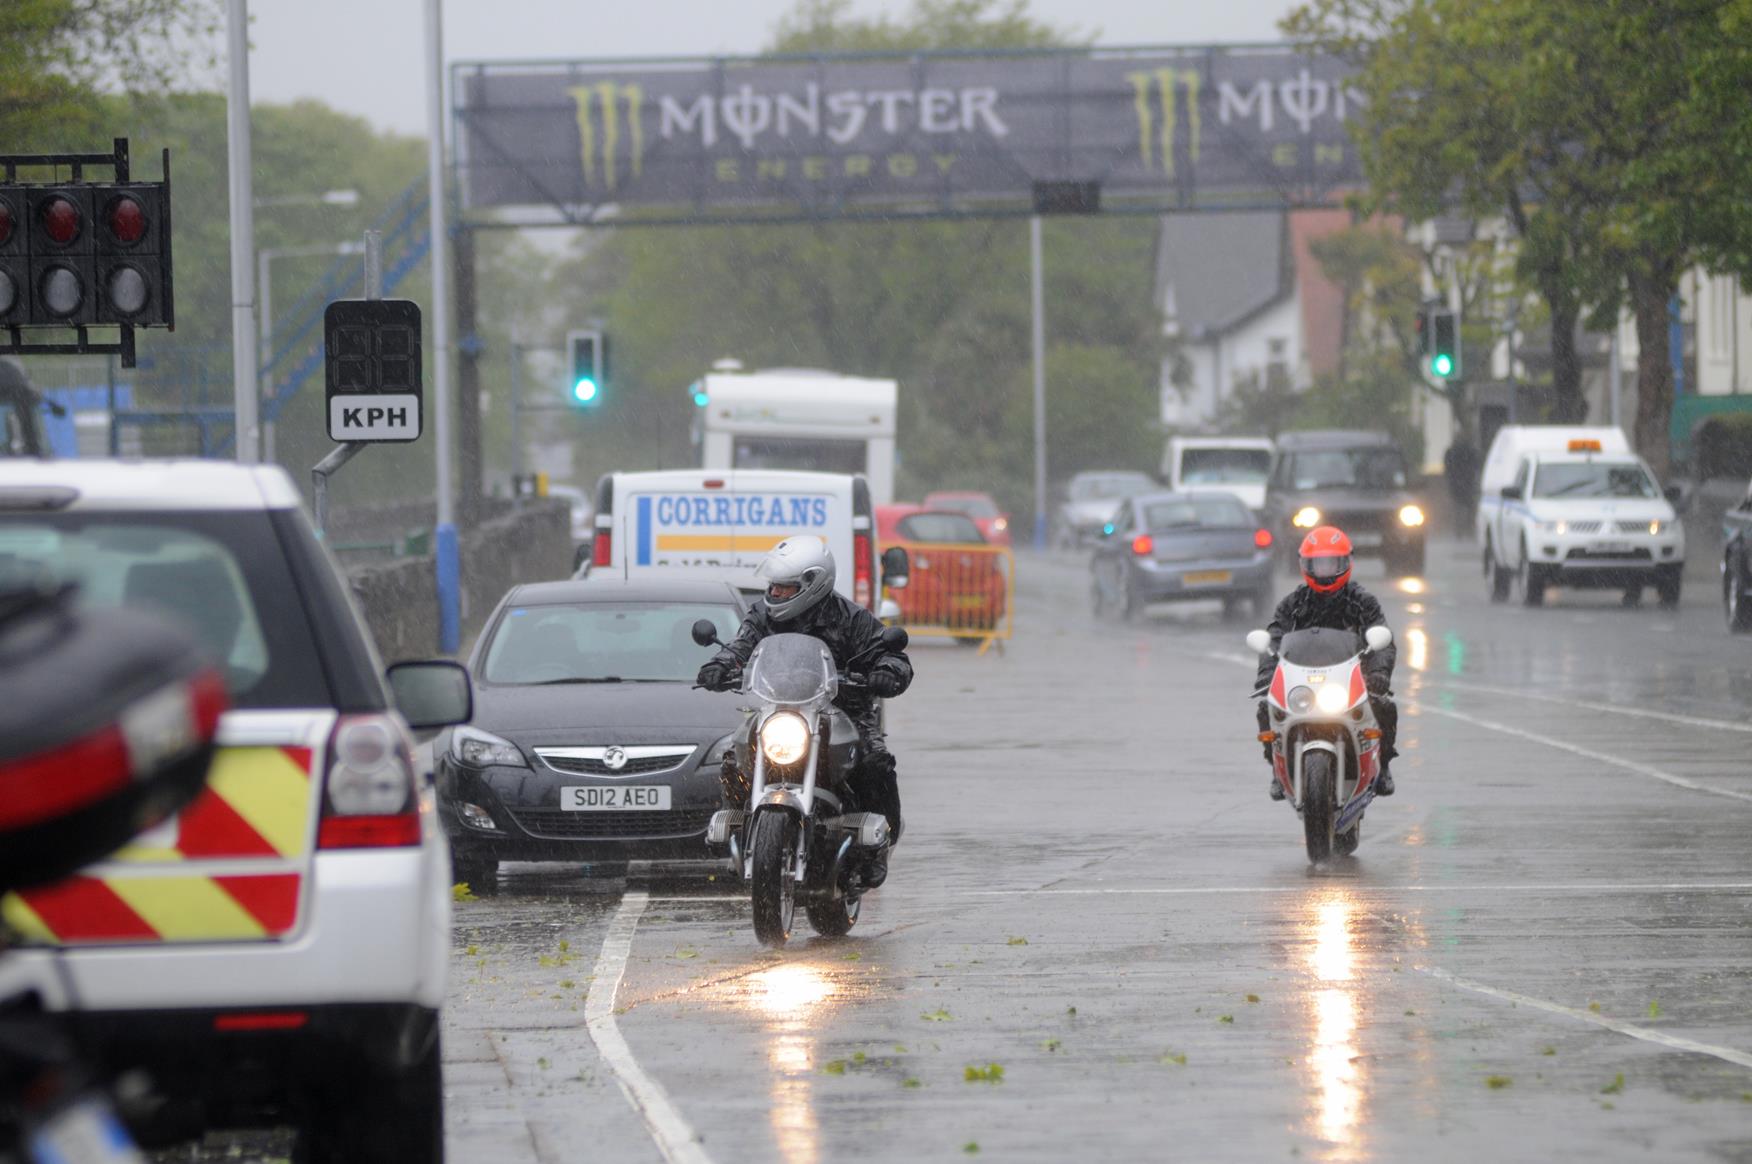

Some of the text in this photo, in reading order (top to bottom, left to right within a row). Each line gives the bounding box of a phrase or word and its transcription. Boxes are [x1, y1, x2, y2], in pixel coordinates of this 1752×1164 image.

[660, 81, 1009, 148] MONSTER
[715, 153, 957, 182] ENERGY
[343, 407, 407, 428] KPH
[657, 496, 827, 527] CORRIGANS
[574, 788, 659, 806] SD12 AEO
